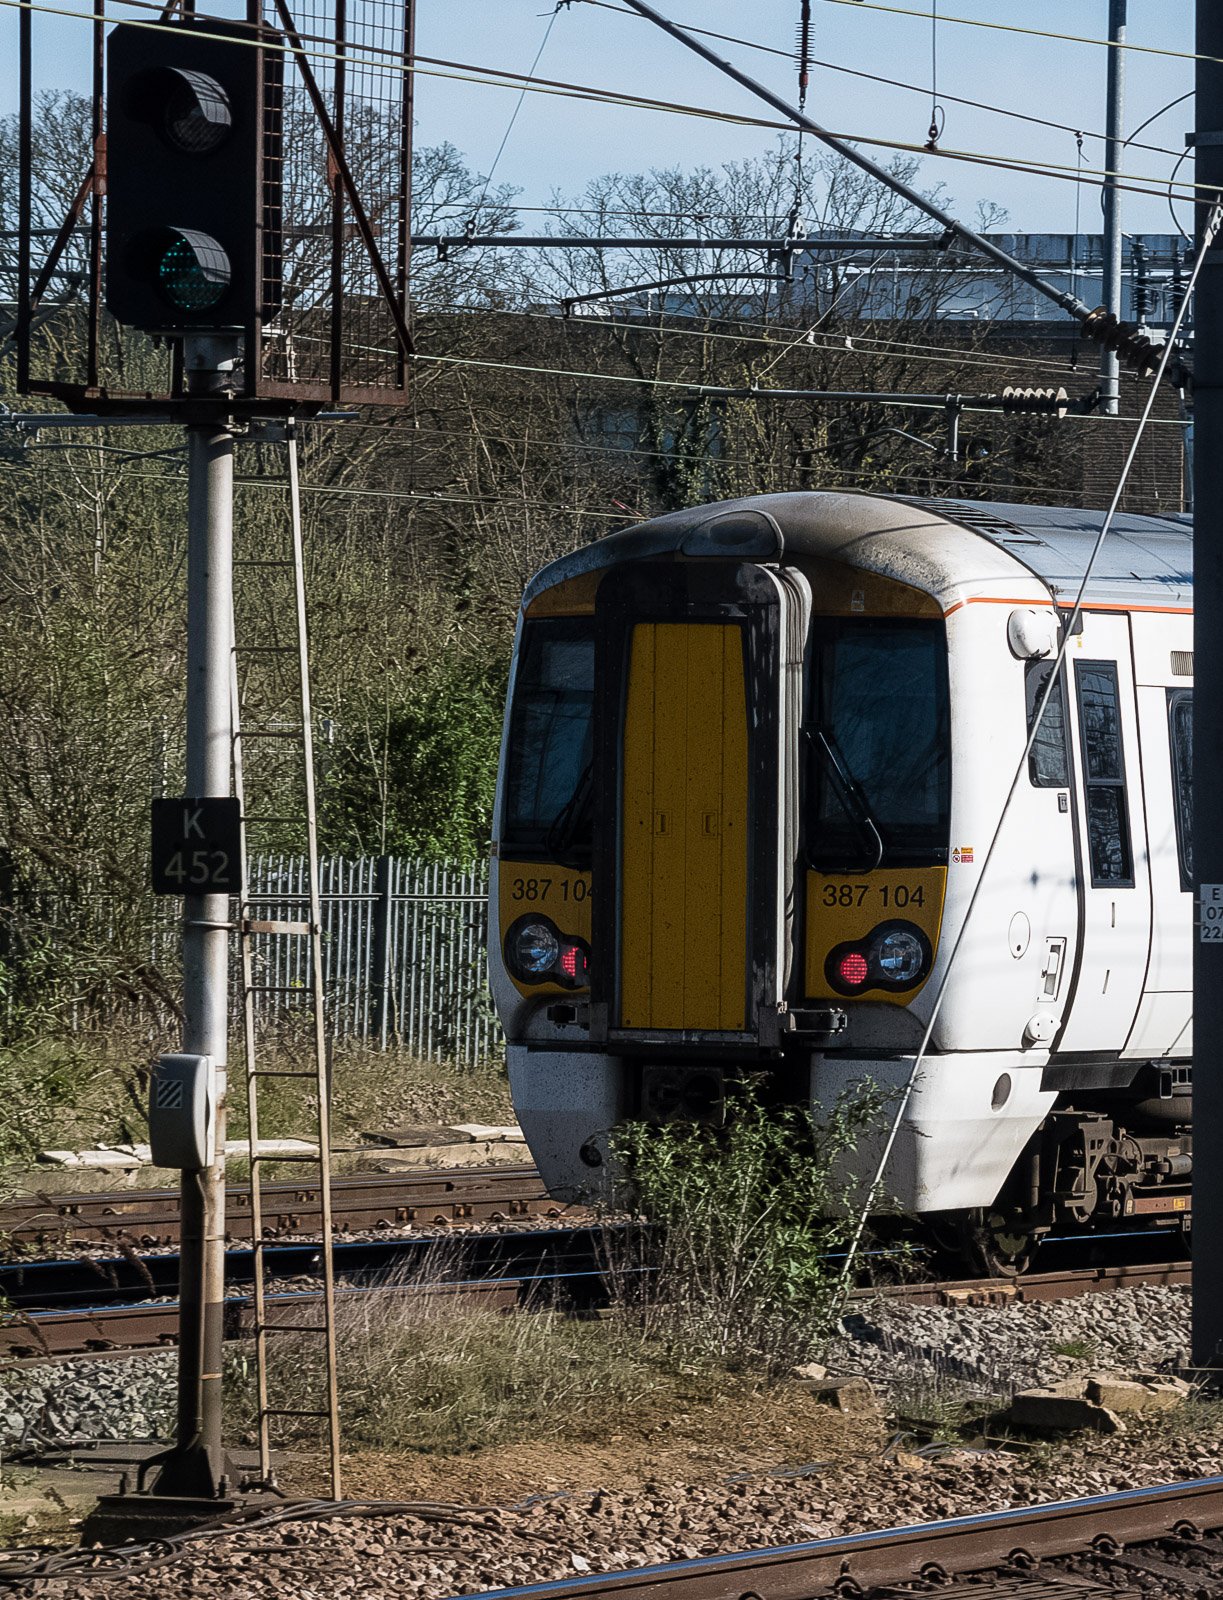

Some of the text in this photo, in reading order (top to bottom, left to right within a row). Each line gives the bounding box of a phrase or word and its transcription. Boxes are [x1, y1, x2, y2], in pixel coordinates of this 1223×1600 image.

[183, 808, 205, 839] K
[164, 850, 230, 884] 452
[512, 878, 552, 901] 387
[822, 884, 925, 908] 387 104
